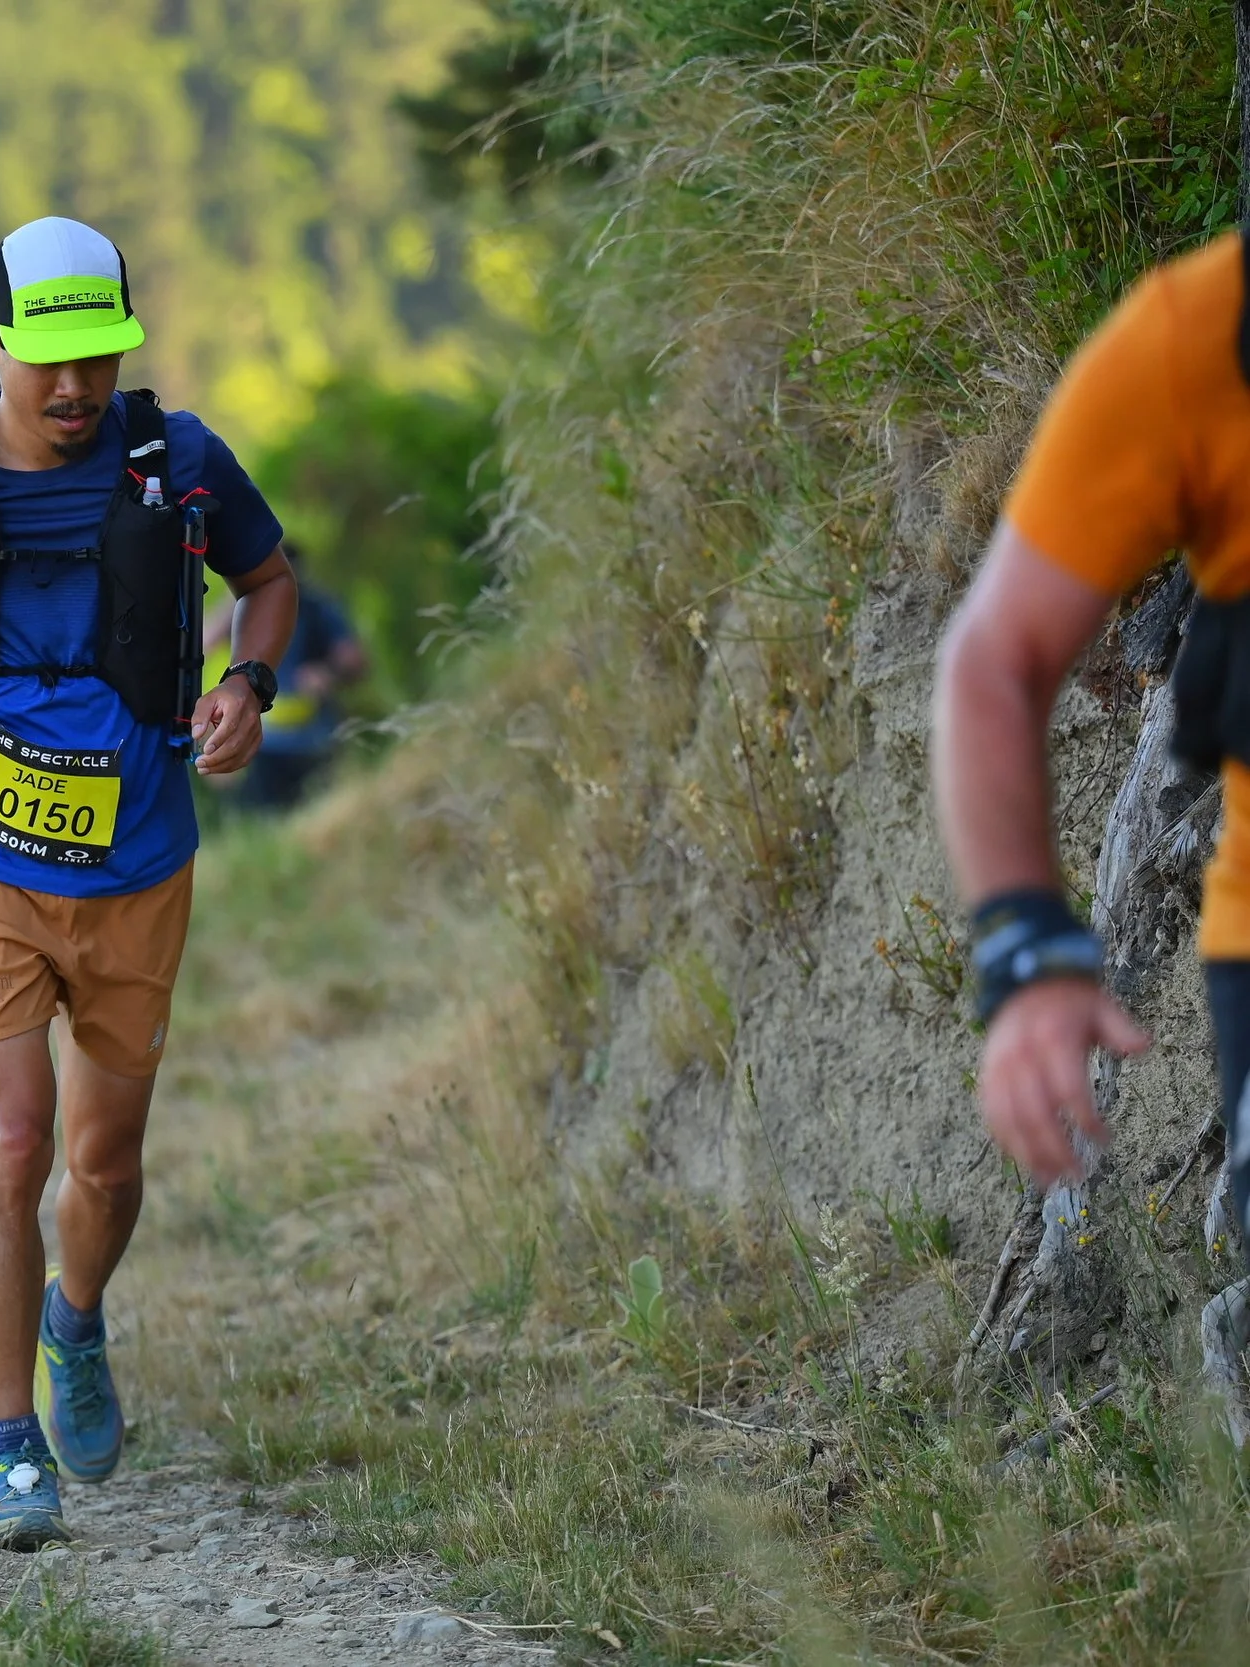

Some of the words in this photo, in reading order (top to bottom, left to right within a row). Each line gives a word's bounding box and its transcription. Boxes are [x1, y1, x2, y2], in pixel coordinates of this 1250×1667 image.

[24, 297, 46, 308] THE
[53, 293, 115, 303] SPECTACLE
[20, 747, 109, 767] SPECTACLE
[12, 767, 68, 794] JADE
[0, 831, 48, 857] 50KM
[57, 856, 93, 864] OAKLEY
